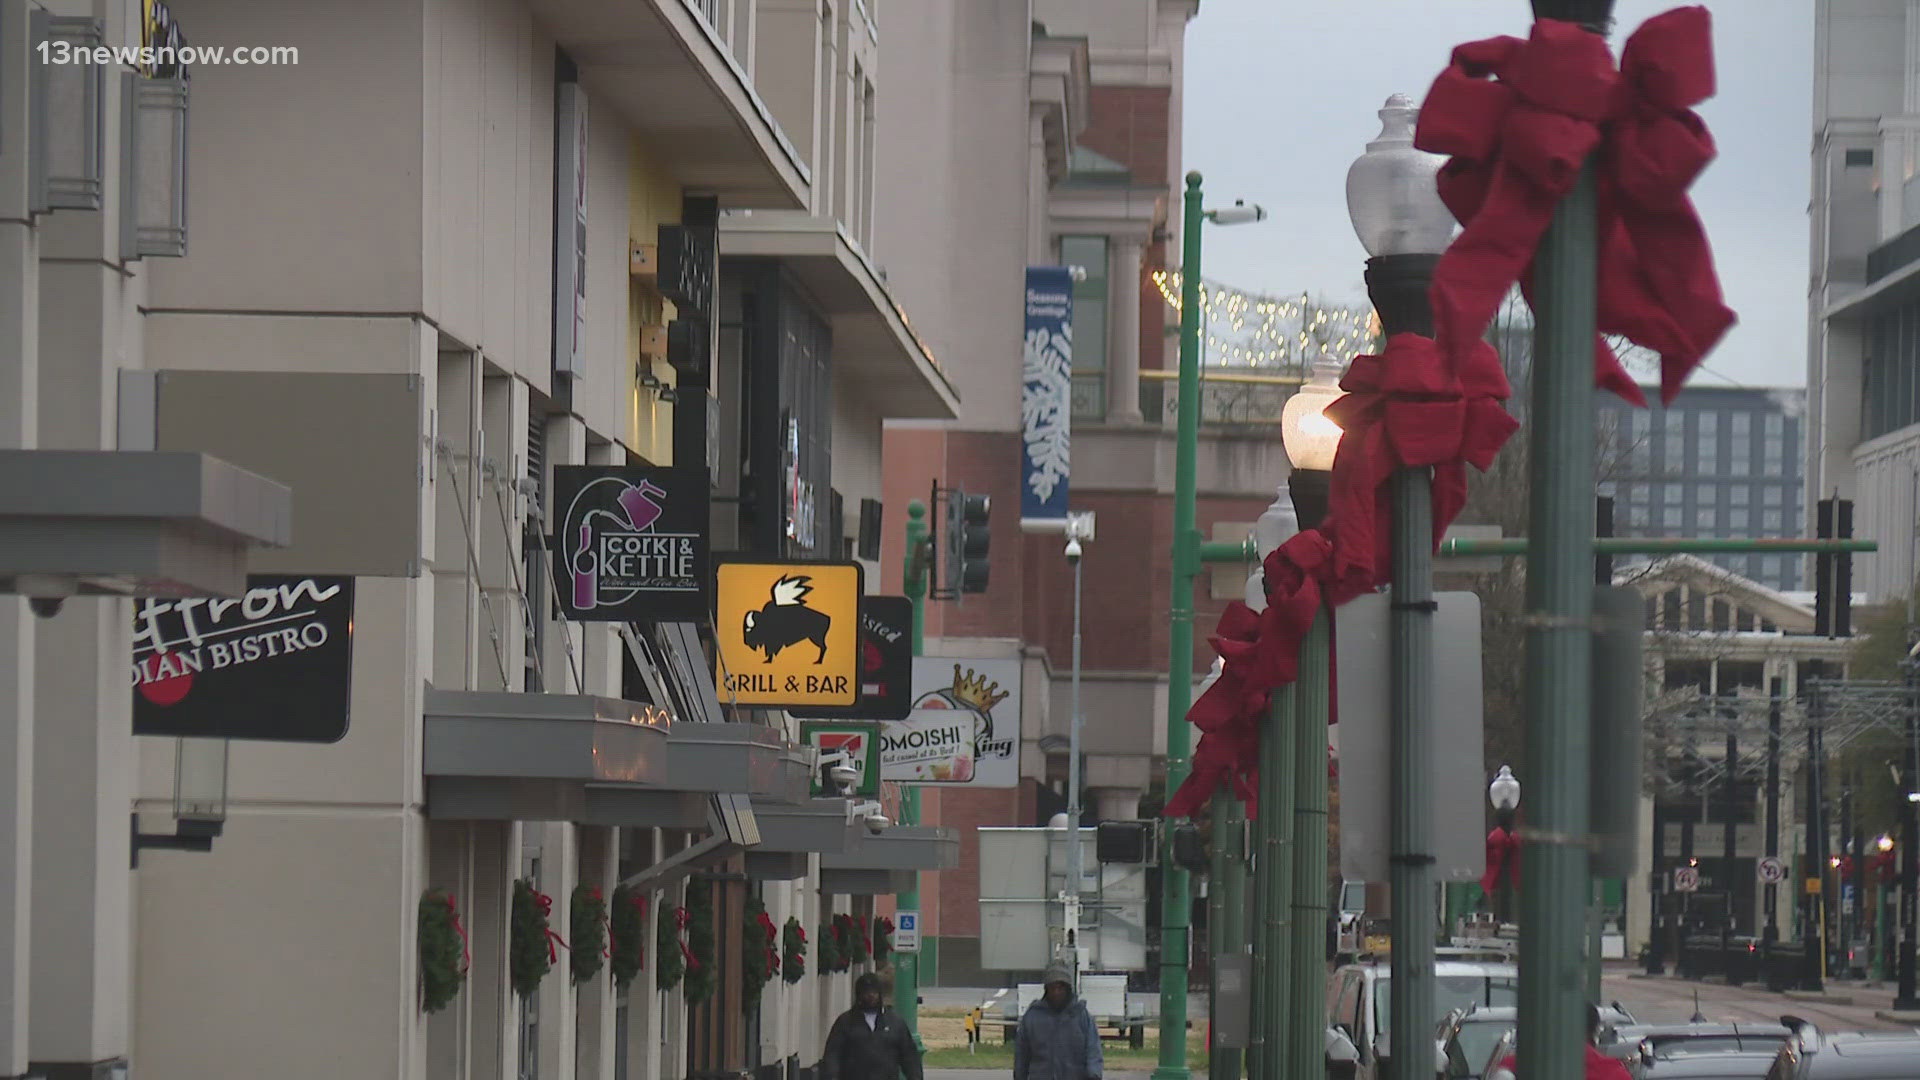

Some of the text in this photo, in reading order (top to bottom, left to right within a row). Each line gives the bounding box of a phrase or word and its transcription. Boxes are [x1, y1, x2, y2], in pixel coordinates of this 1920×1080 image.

[601, 537, 694, 577] KETTLE
[680, 538, 693, 555] &
[208, 622, 328, 669] BISTRO
[723, 674, 848, 694] GRILL & BAR
